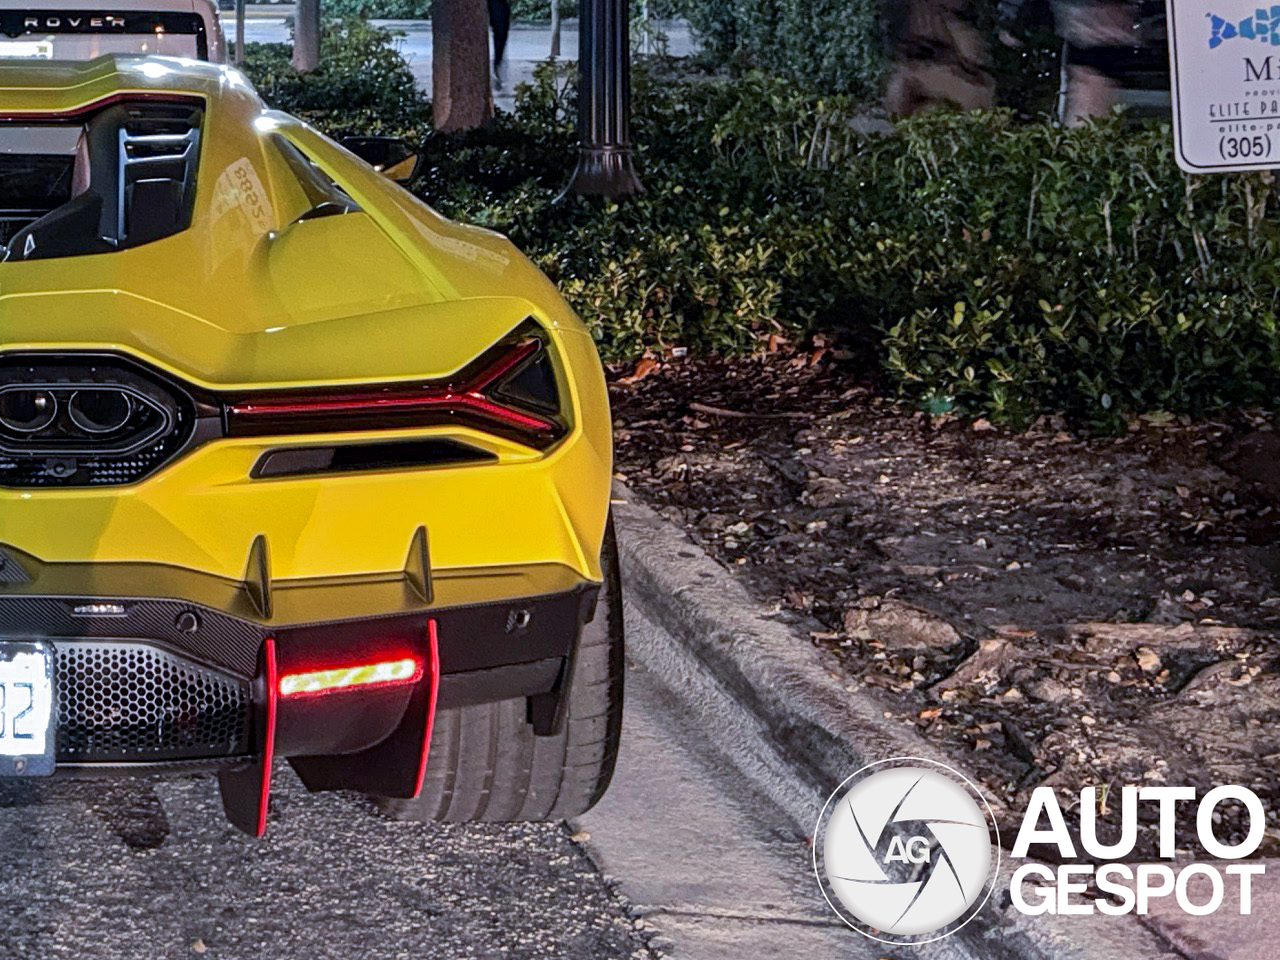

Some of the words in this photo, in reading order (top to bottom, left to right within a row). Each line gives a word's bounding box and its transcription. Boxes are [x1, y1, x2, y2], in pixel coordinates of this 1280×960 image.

[24, 16, 126, 28] ROVER
[1209, 102, 1250, 118] ELITE
[1219, 133, 1271, 160] (305)
